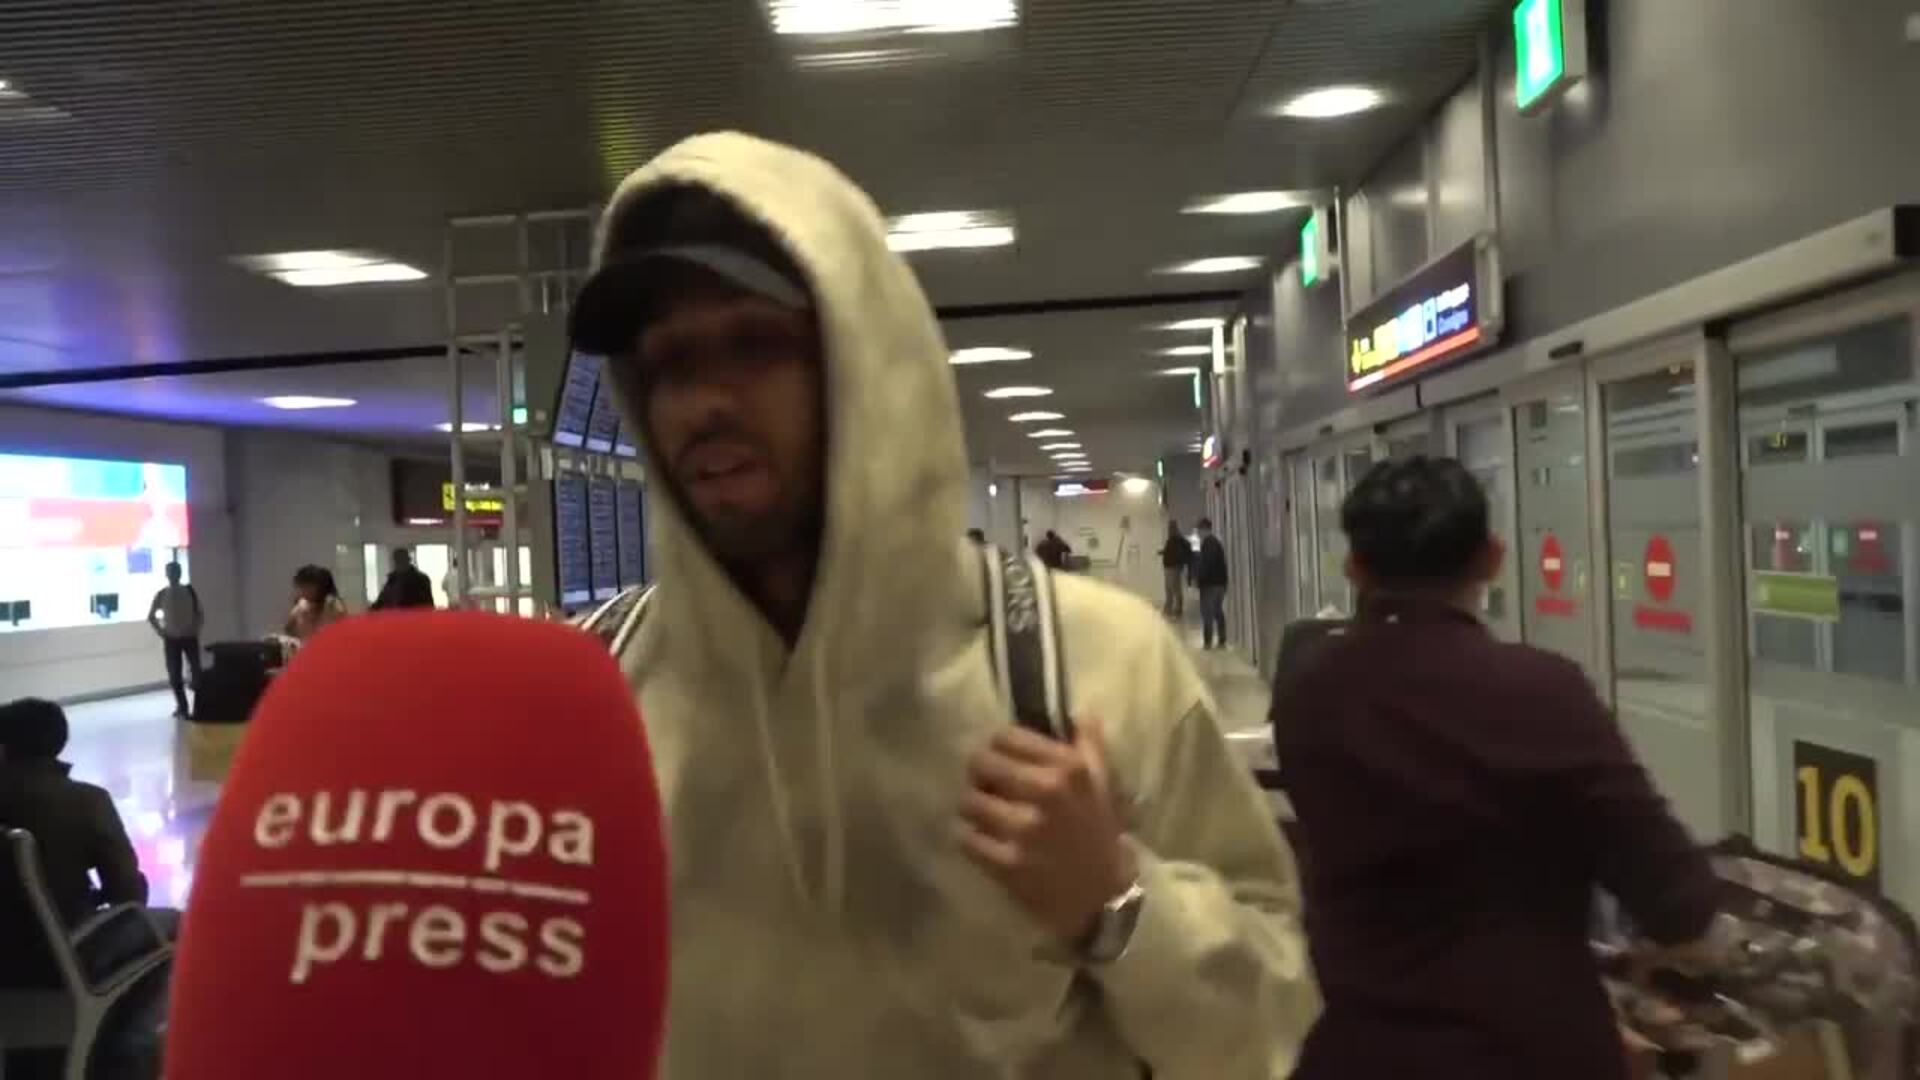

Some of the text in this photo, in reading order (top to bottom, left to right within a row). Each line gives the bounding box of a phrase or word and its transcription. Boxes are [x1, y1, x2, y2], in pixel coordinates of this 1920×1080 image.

[252, 788, 596, 871] europa
[1797, 764, 1874, 877] 10
[290, 899, 586, 984] press
